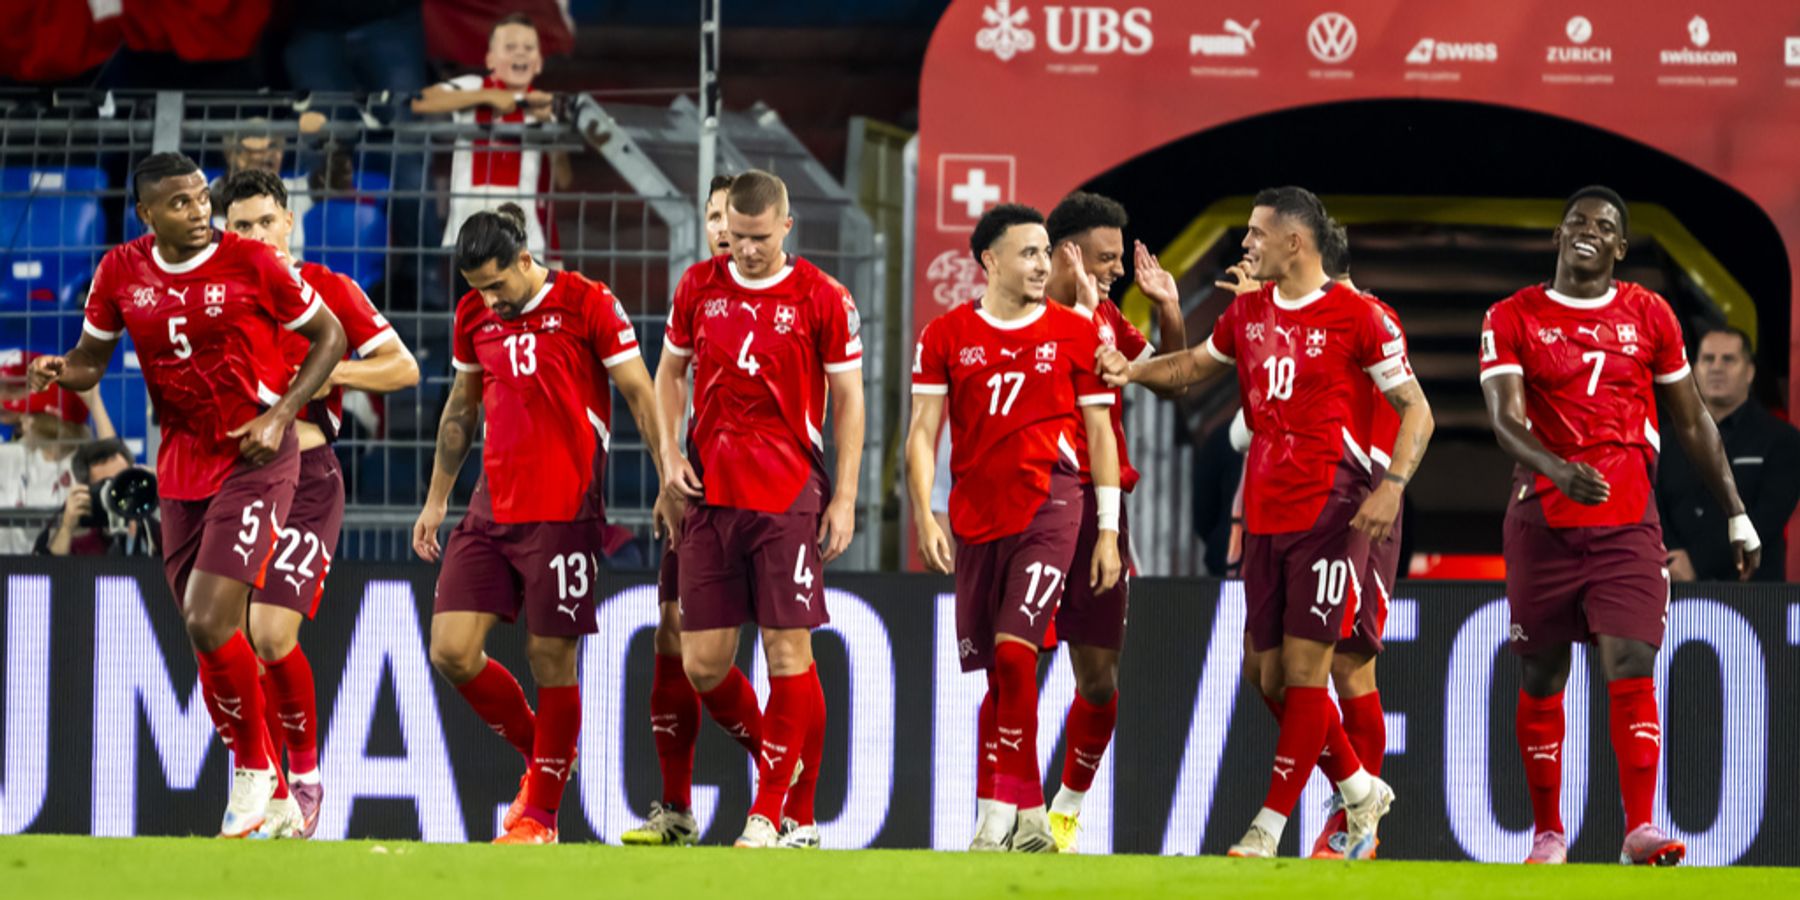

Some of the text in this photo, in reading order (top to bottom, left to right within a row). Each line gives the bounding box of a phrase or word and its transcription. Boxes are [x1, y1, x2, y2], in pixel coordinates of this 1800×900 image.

[1044, 7, 1153, 54] UBS
[1437, 42, 1498, 60] SWISS
[1546, 46, 1612, 62] ZURICH
[1660, 49, 1737, 65] swisscom
[168, 316, 193, 360] 5
[503, 332, 537, 377] 13
[736, 331, 761, 376] 4
[986, 371, 1026, 416] 17
[1263, 355, 1296, 401] 10
[1581, 351, 1606, 396] 7
[238, 500, 263, 545] 5
[273, 526, 320, 580] 22
[793, 544, 814, 589] 4
[549, 552, 590, 600] 13
[1024, 561, 1062, 609] 17
[1311, 558, 1347, 606] 10
